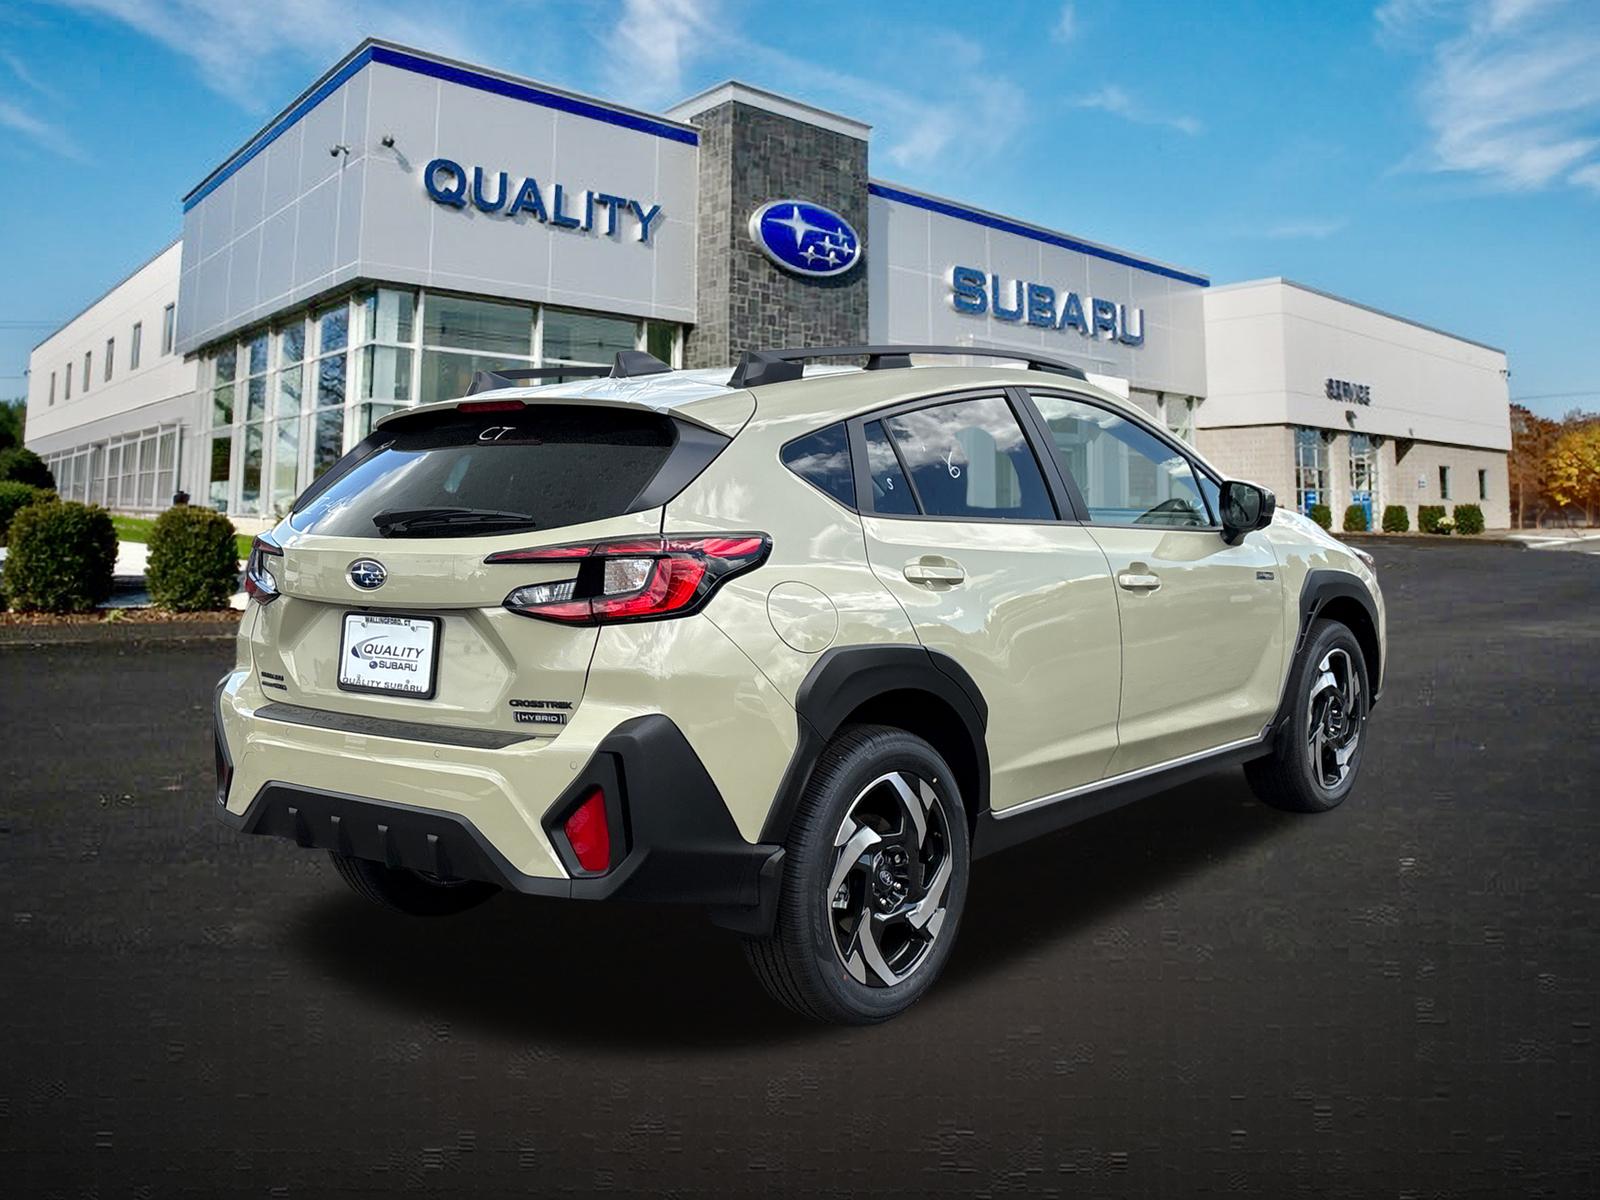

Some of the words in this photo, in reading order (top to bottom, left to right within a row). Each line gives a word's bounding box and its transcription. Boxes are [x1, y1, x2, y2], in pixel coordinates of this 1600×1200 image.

[424, 158, 661, 243] QUALITY
[950, 265, 1145, 347] SUBARU
[1325, 378, 1371, 407] SERVICE
[363, 643, 425, 659] QUALITY
[378, 660, 418, 672] SUBARU
[342, 677, 381, 688] QUALITY
[384, 681, 423, 692] SUBARU
[509, 699, 573, 710] CROSSTREK
[521, 714, 559, 722] HYBRID
